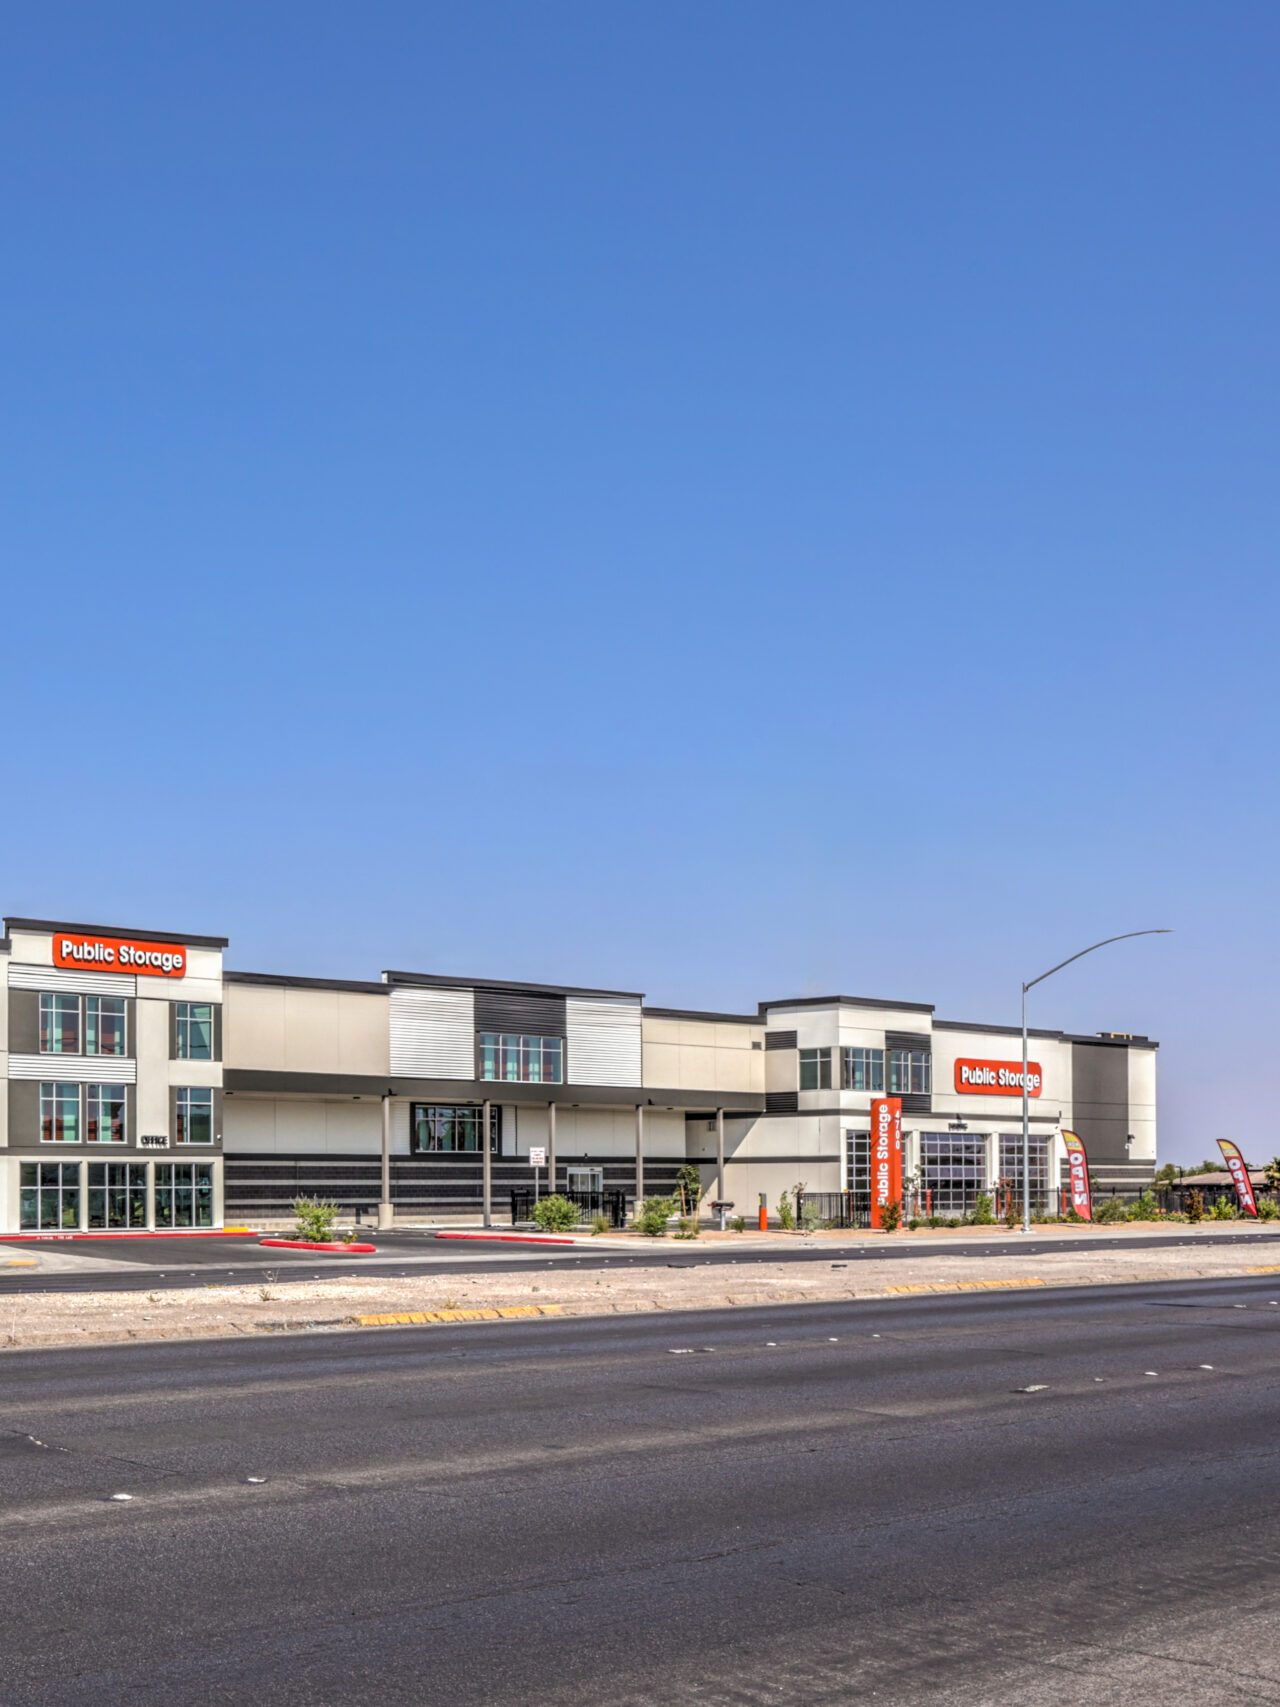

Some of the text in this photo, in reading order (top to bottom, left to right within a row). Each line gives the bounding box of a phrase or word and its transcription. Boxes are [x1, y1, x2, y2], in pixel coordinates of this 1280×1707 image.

[61, 940, 183, 971] Public Storage
[961, 1066, 996, 1085] Public
[141, 1135, 168, 1146] OFFICE
[877, 1104, 891, 1159] Storage
